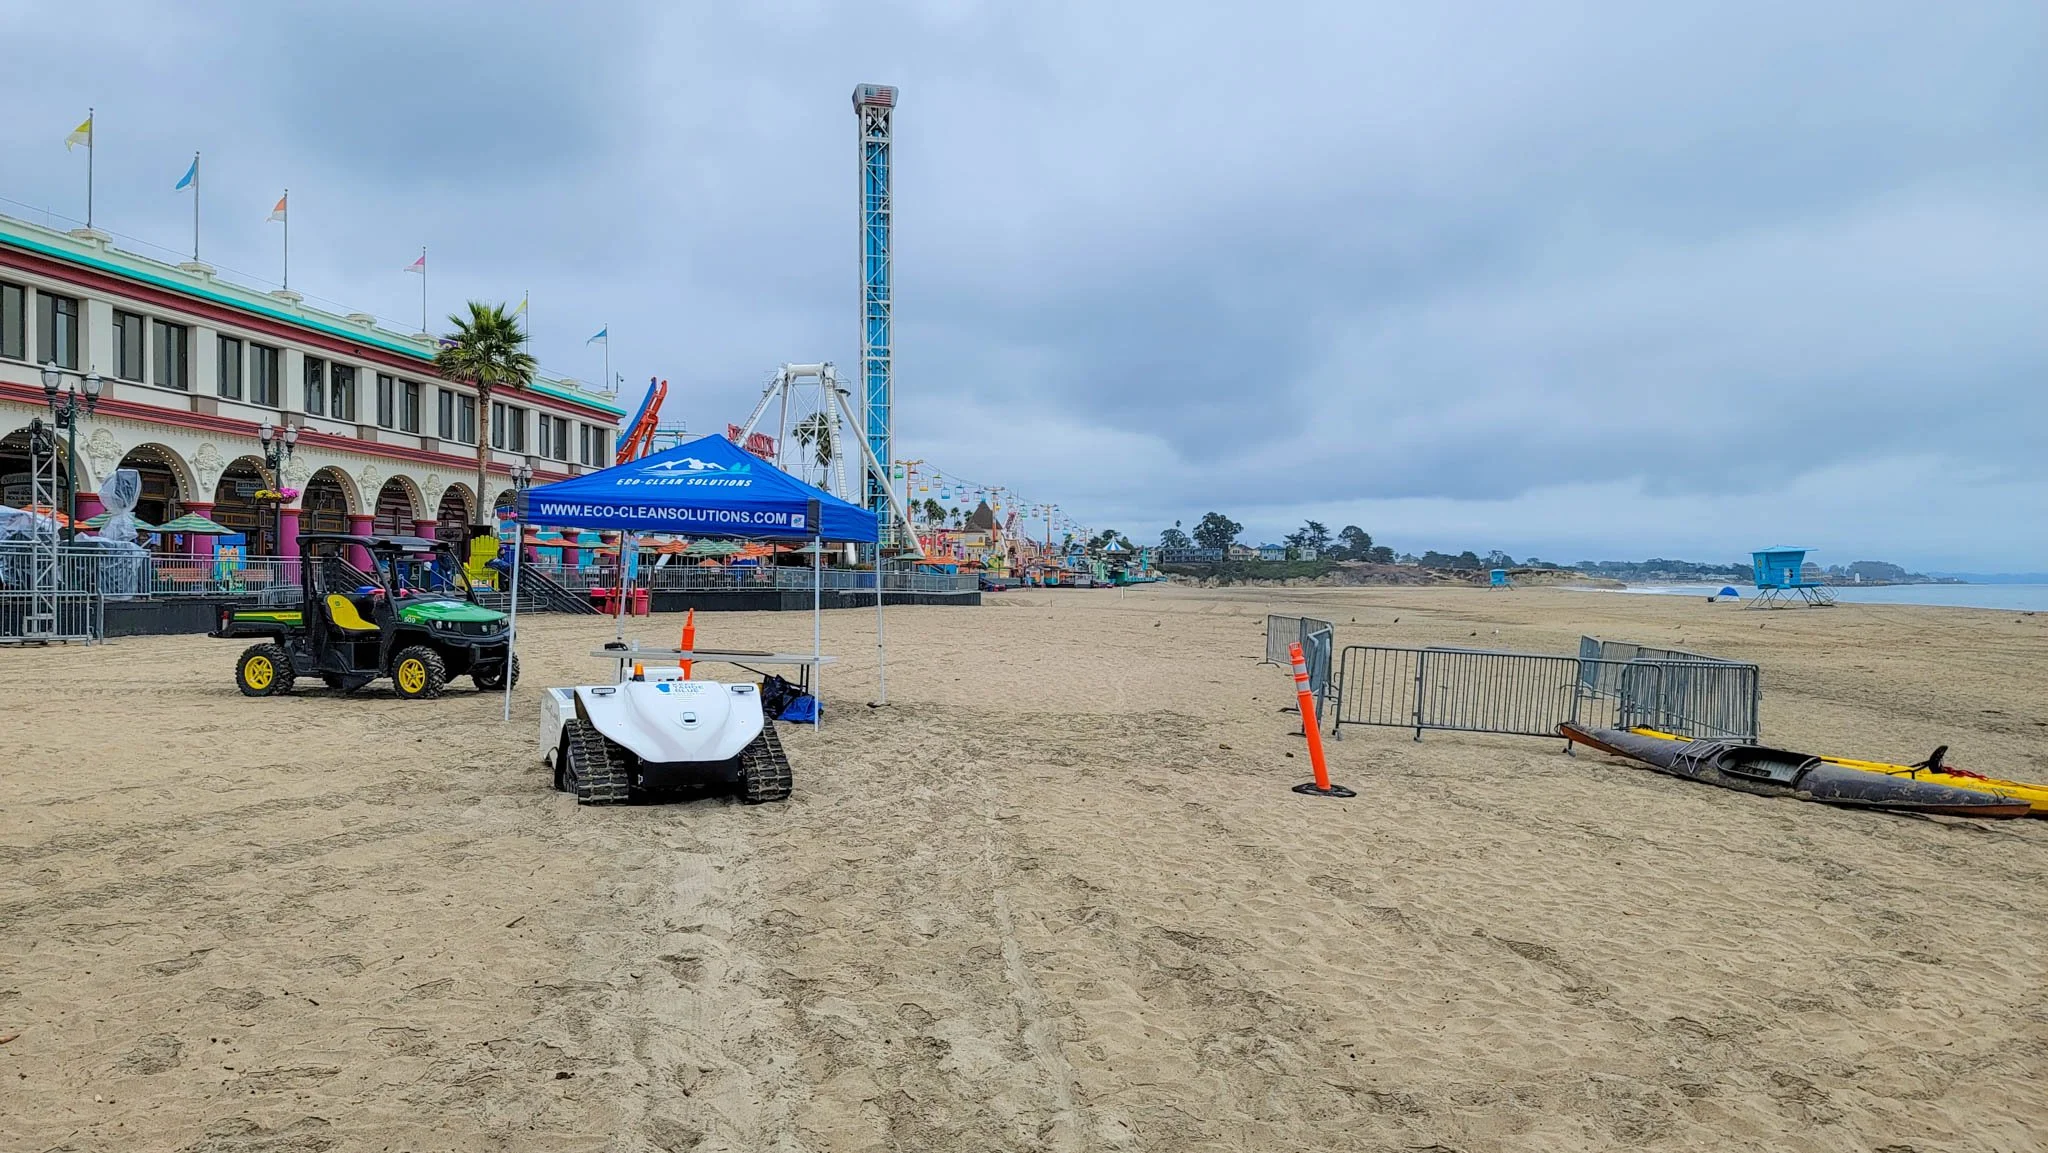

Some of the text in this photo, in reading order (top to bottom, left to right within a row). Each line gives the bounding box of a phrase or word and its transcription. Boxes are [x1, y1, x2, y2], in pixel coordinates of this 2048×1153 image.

[616, 478, 753, 487] ECO-CLEAN SOLUTIONS
[540, 503, 787, 525] WWW.ECO-CLEANSOLUTIONS.COM
